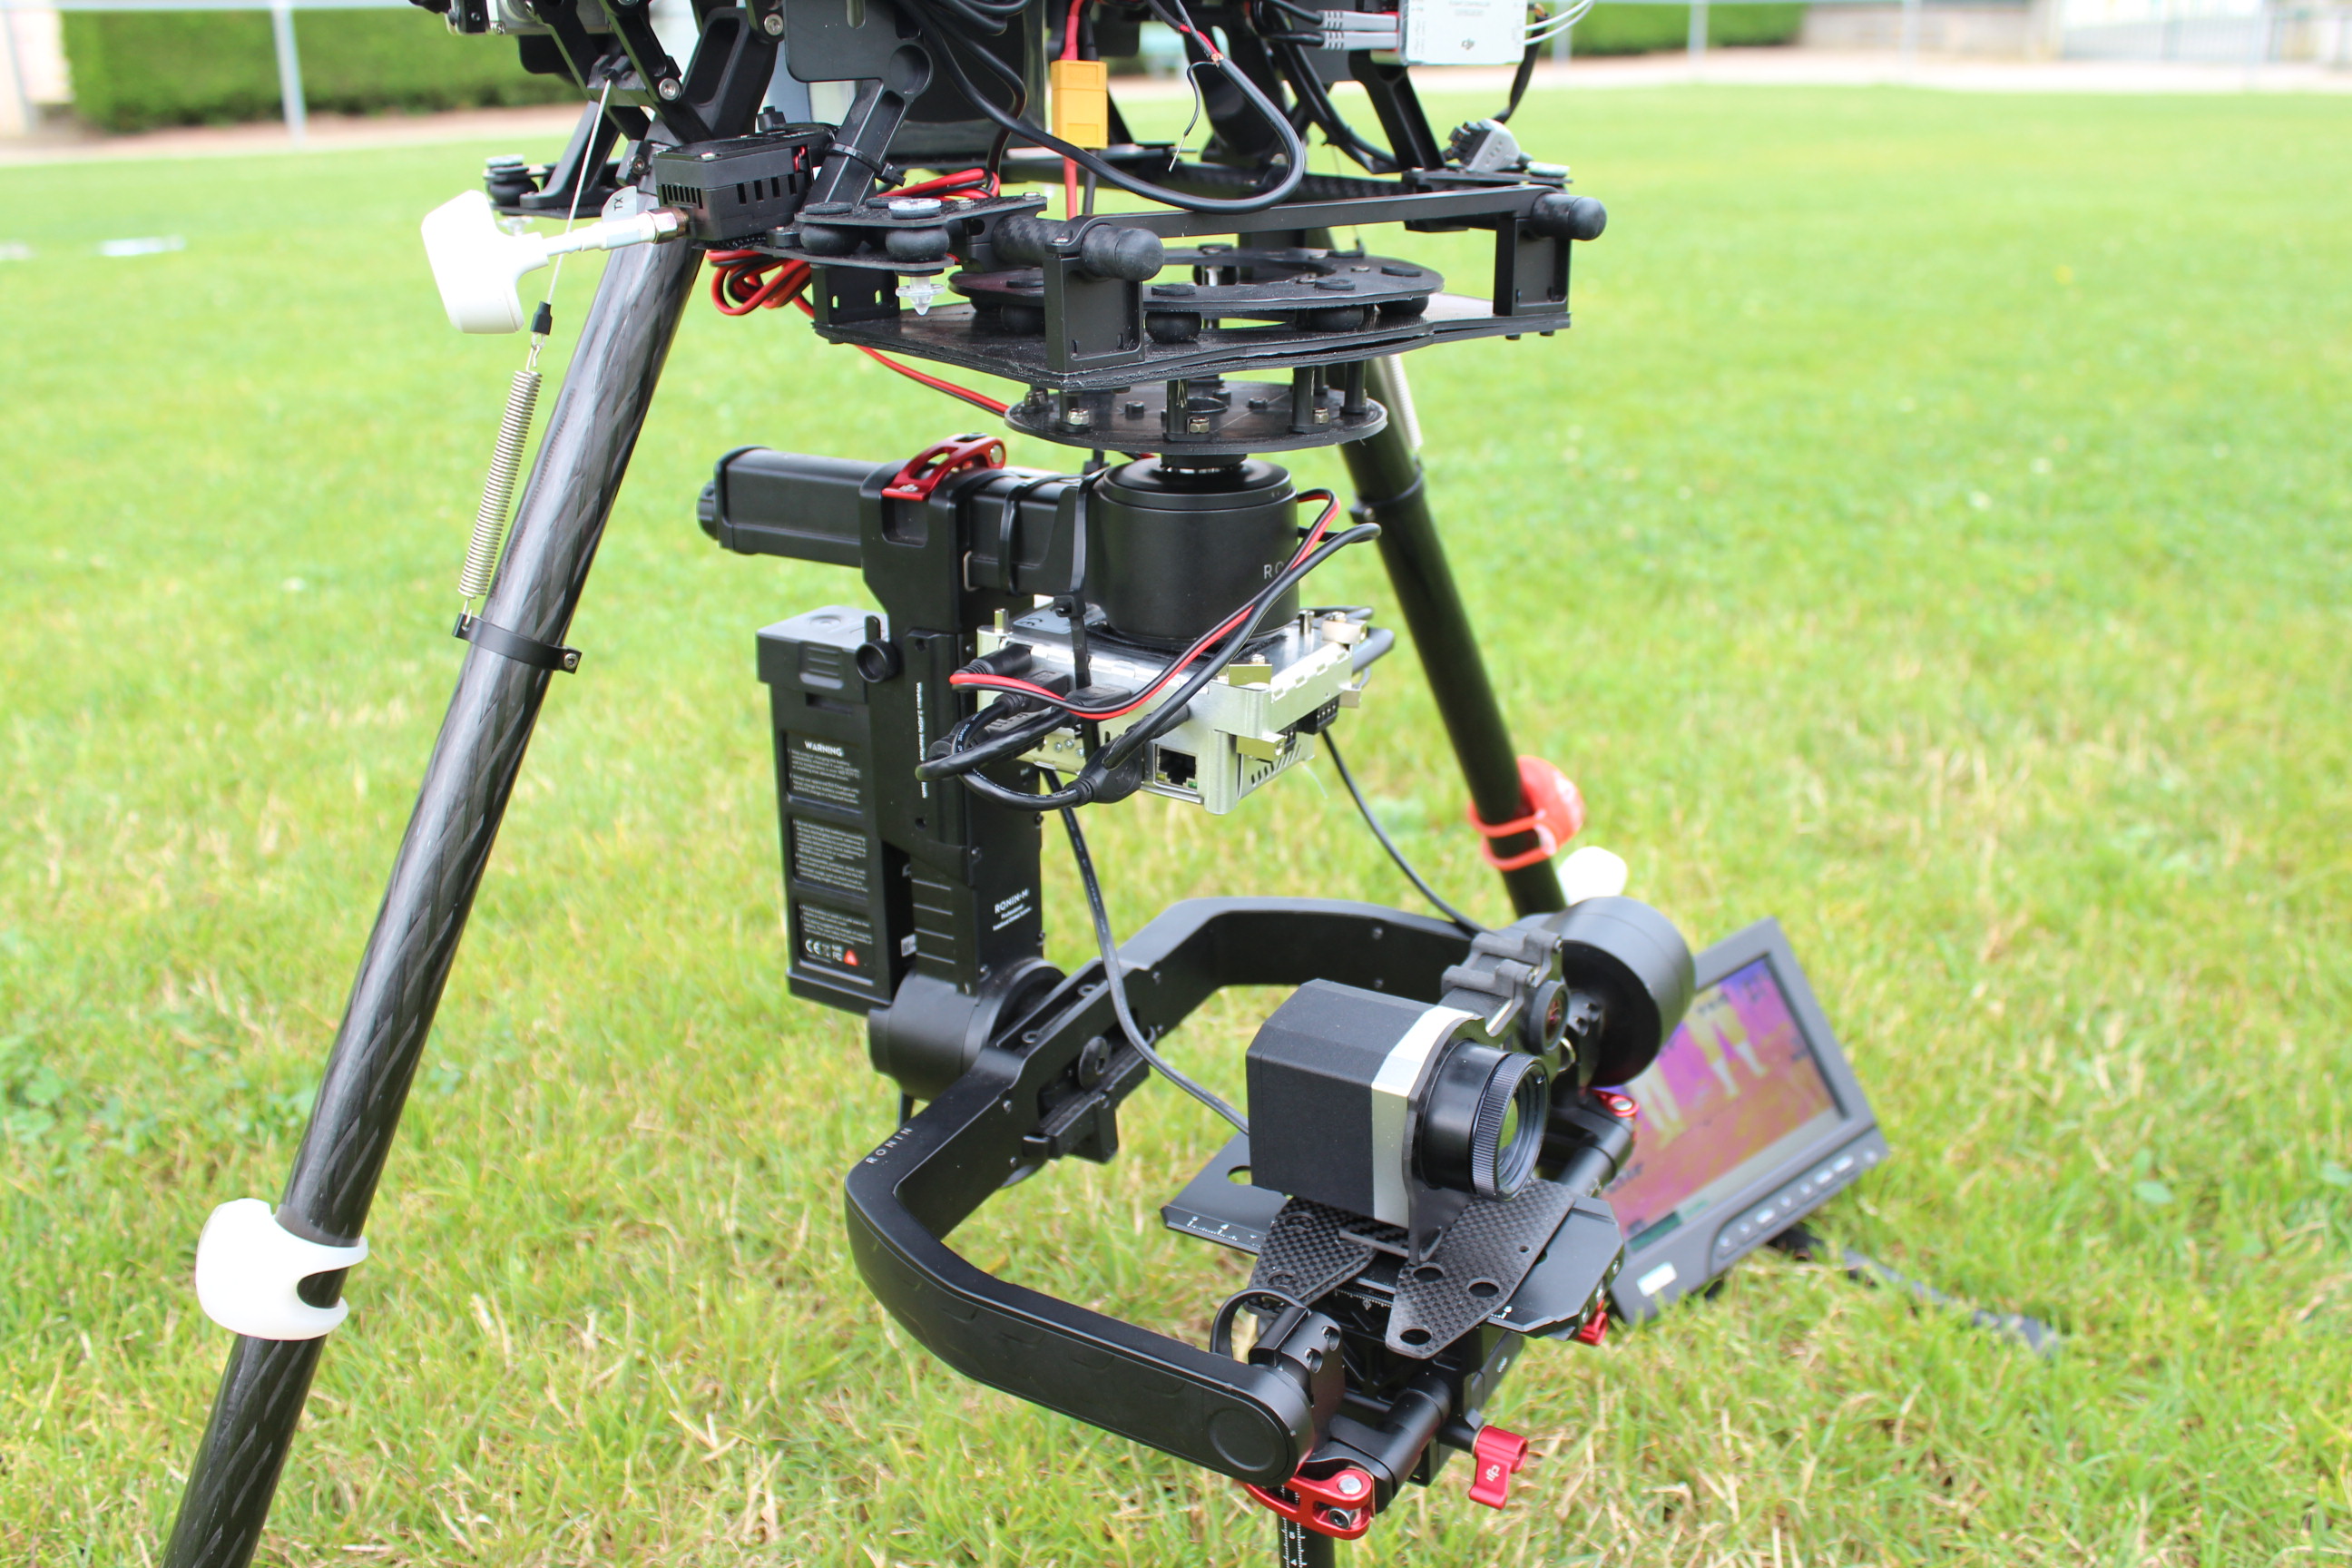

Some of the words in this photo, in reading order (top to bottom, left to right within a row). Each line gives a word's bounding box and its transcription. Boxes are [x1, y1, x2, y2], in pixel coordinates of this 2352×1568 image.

[614, 197, 623, 211] TX
[804, 740, 844, 757] WARNING
[866, 1127, 913, 1164] RONIN
